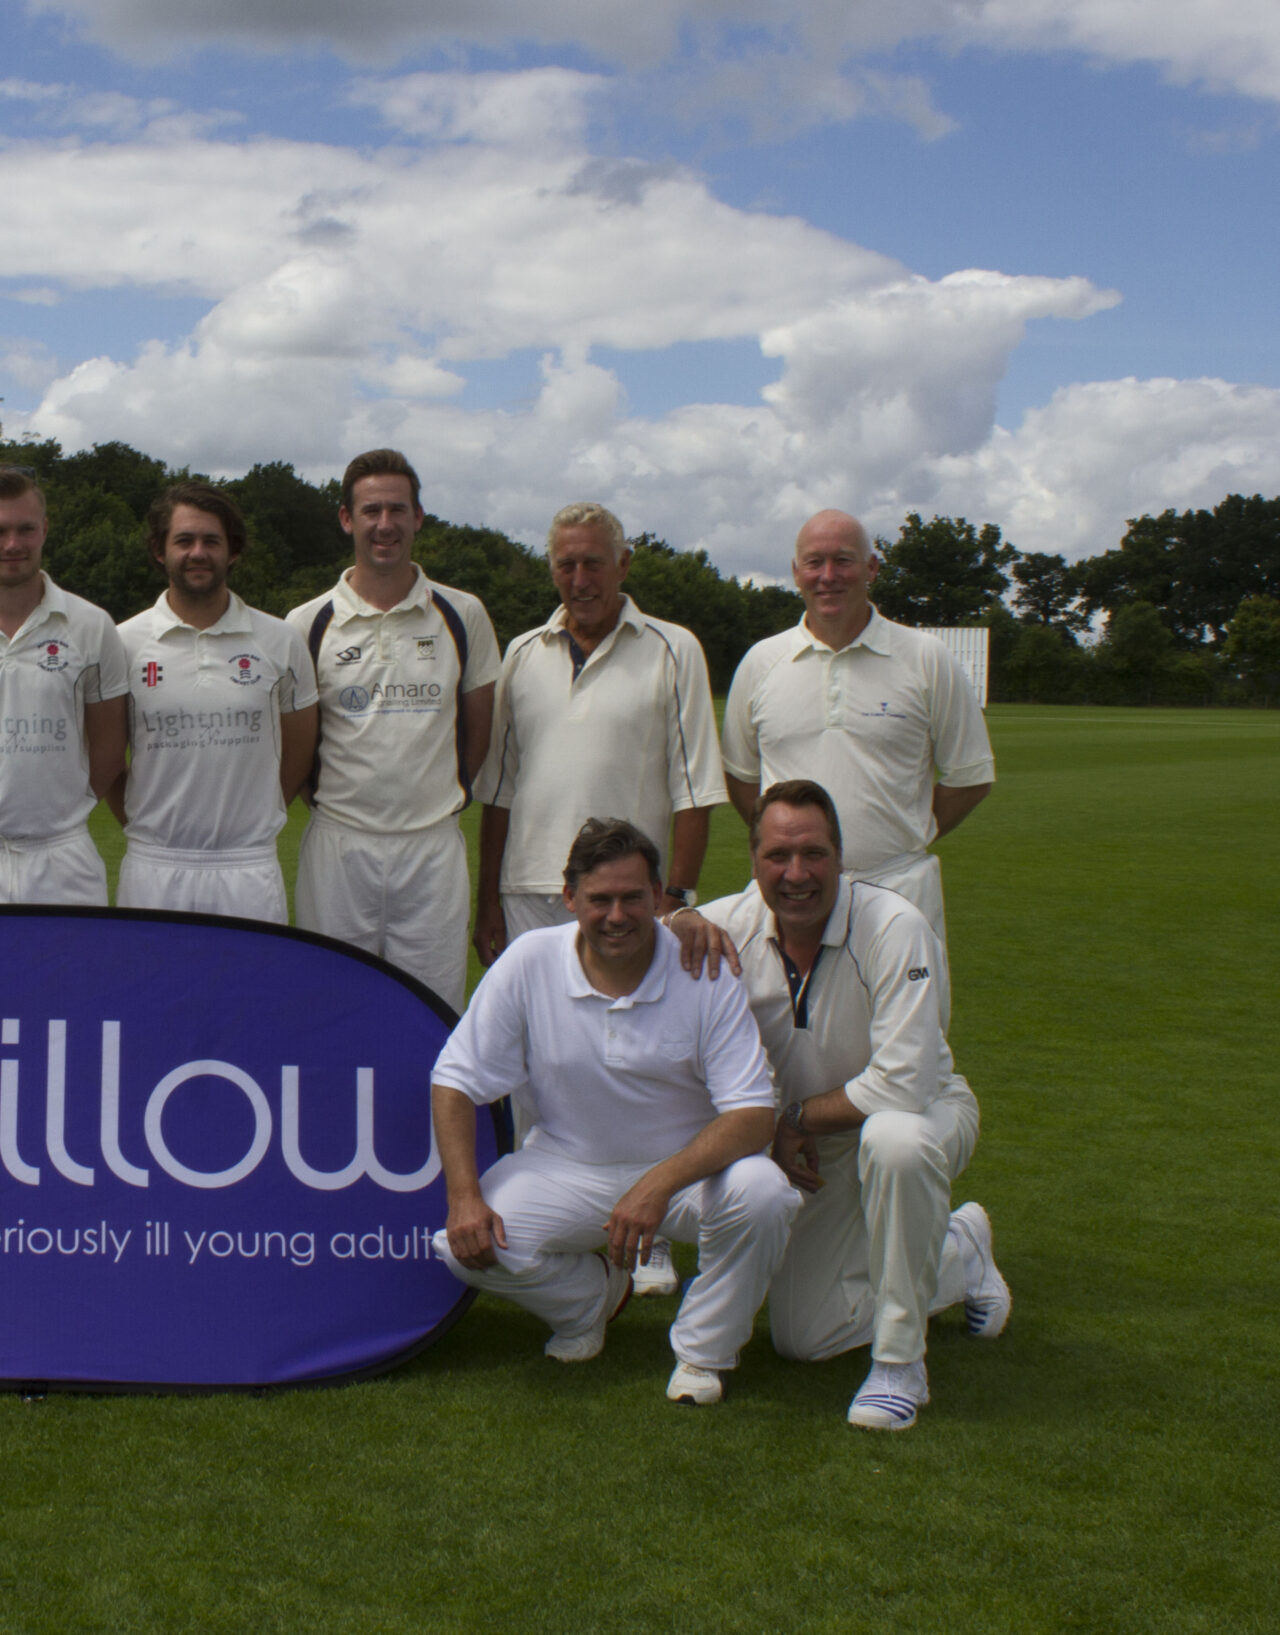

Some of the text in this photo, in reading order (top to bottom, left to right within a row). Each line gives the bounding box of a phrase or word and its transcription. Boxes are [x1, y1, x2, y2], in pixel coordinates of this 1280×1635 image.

[371, 683, 441, 699] Amaro
[141, 706, 263, 737] Lightning
[907, 967, 930, 981] GM
[146, 1221, 169, 1256] ill
[184, 1230, 315, 1266] young
[330, 1225, 448, 1260] adult
